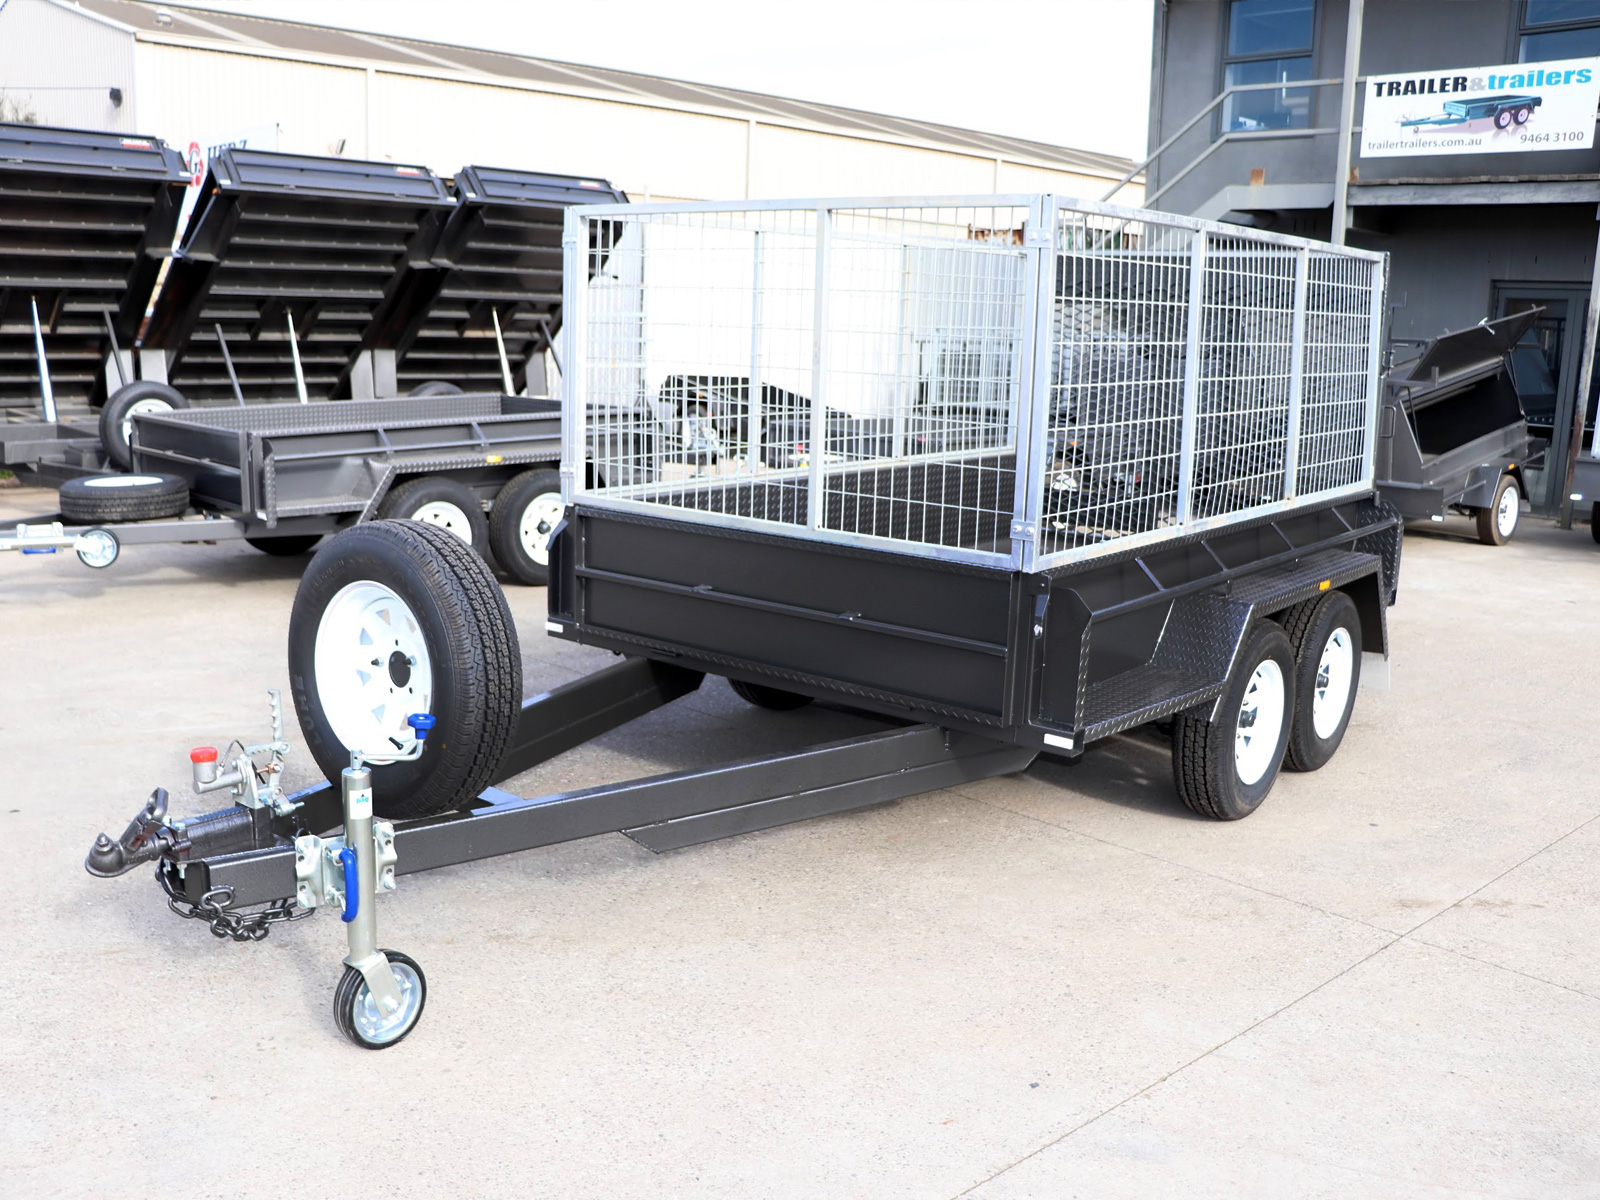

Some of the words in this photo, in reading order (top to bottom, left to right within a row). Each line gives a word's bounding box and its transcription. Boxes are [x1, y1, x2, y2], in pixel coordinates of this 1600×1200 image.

[1368, 136, 1482, 150] trailertrailers.com.au
[1520, 134, 1549, 144] 9464
[1553, 131, 1584, 142] 3100
